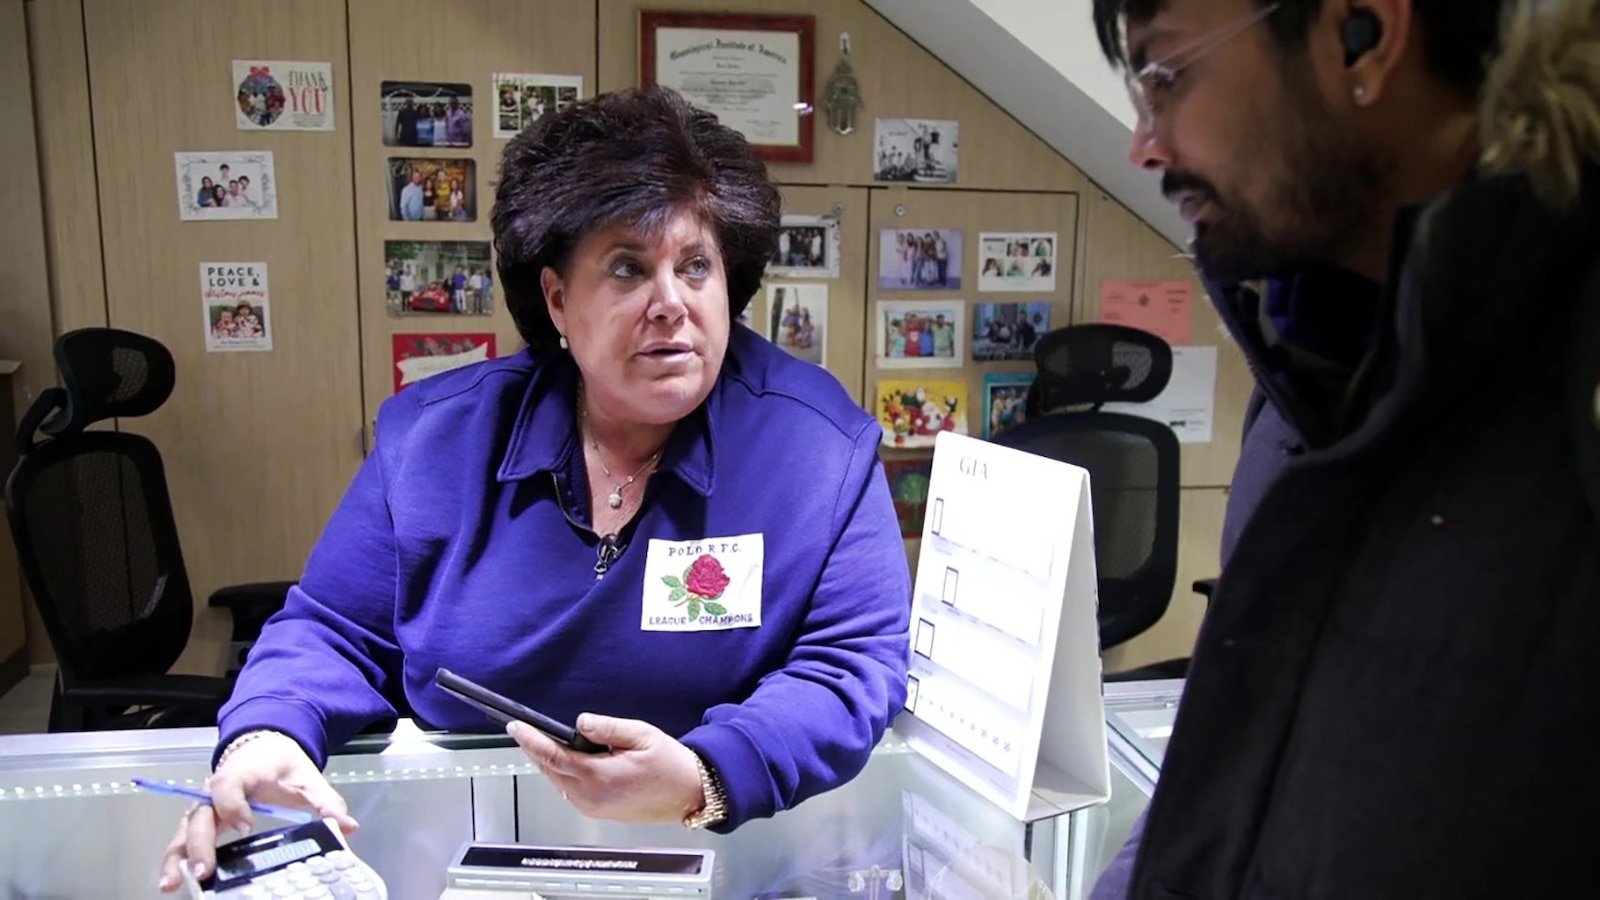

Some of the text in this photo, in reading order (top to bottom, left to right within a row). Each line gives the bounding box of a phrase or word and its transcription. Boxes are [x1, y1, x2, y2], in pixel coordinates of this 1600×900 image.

[289, 70, 328, 92] THANK
[289, 87, 327, 114] YOU
[207, 267, 260, 277] PEACE,
[209, 278, 260, 287] LOVE &
[959, 455, 988, 480] GIA
[668, 546, 702, 557] POLO
[649, 616, 687, 626] LEAGUE
